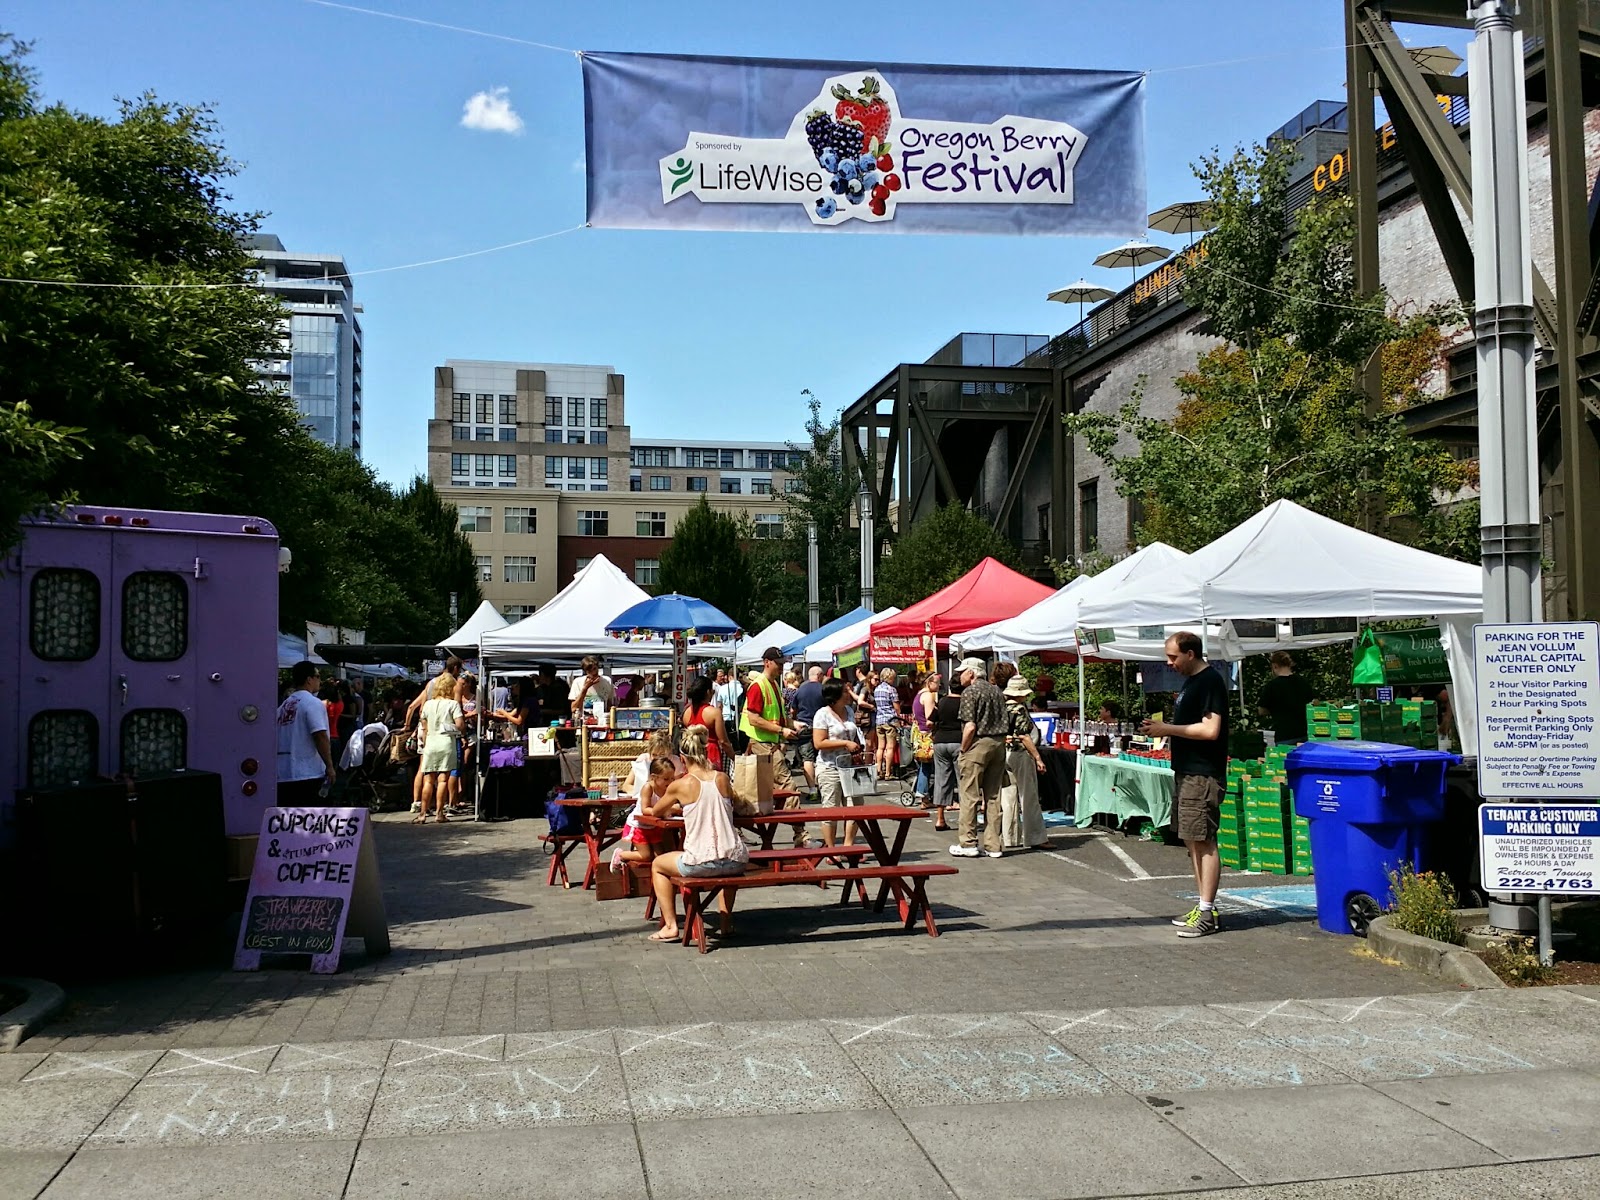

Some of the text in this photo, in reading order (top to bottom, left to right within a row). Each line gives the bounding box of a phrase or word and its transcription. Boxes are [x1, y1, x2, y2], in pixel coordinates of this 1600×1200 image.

[695, 141, 742, 151] Sponsored by
[900, 127, 1077, 160] Oregon Berry
[700, 163, 822, 192] LifeWise
[902, 149, 1065, 194] Festival
[1409, 633, 1442, 653] Unge
[1485, 633, 1534, 641] PARKING
[1498, 643, 1575, 652] JEAN VOLLUM
[1486, 654, 1586, 663] NATURAL CAPITAL
[675, 640, 685, 700] MPLINGS
[1499, 665, 1576, 673] CENTER ONLY
[1553, 680, 1587, 688] Parking
[1526, 690, 1576, 698] Designated
[1524, 700, 1558, 708] Parking
[1561, 700, 1587, 708] Spots
[1535, 724, 1569, 732] Parking
[1572, 724, 1593, 732] Only
[1508, 733, 1574, 741] Monday-Friday
[1487, 809, 1598, 821] TENANT & CUSTOMER
[268, 813, 360, 837] CUPCAKES
[1507, 822, 1580, 834] PARKING ONLY
[268, 838, 354, 860] & STUMPTOWN
[278, 861, 352, 884] COFFEE
[1497, 867, 1592, 878] Retriever Towing
[1499, 878, 1593, 888] 222-4763
[255, 899, 336, 916] STRAWBERRY
[255, 915, 335, 932] SHORTCAKE!
[246, 935, 283, 948] (BEST
[289, 937, 300, 948] IN
